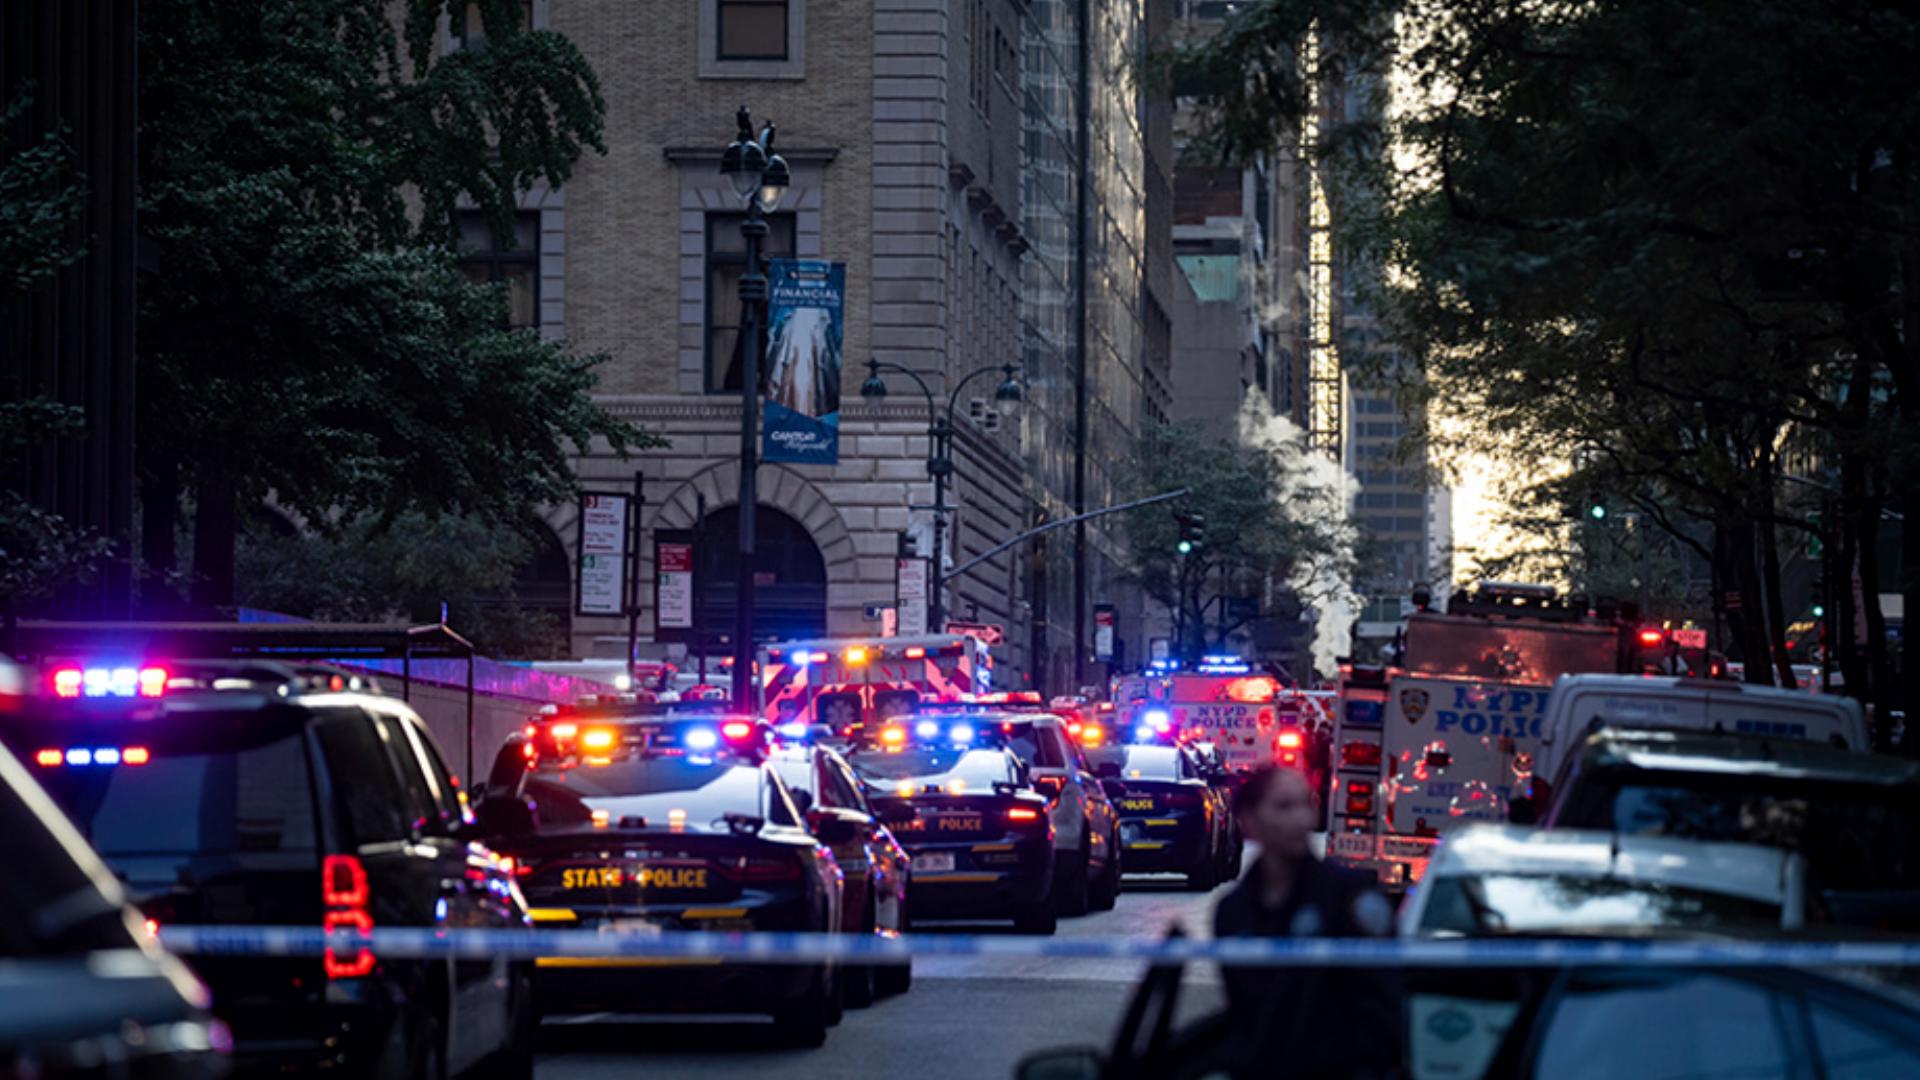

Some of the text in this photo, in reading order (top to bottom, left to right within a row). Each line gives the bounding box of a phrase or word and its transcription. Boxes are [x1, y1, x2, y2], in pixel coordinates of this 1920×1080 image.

[773, 288, 839, 299] FINANCIAL
[1198, 705, 1247, 716] NYPD
[1190, 717, 1256, 729] POLICE
[939, 817, 982, 831] POLICE
[562, 868, 707, 889] STATE POLICE
